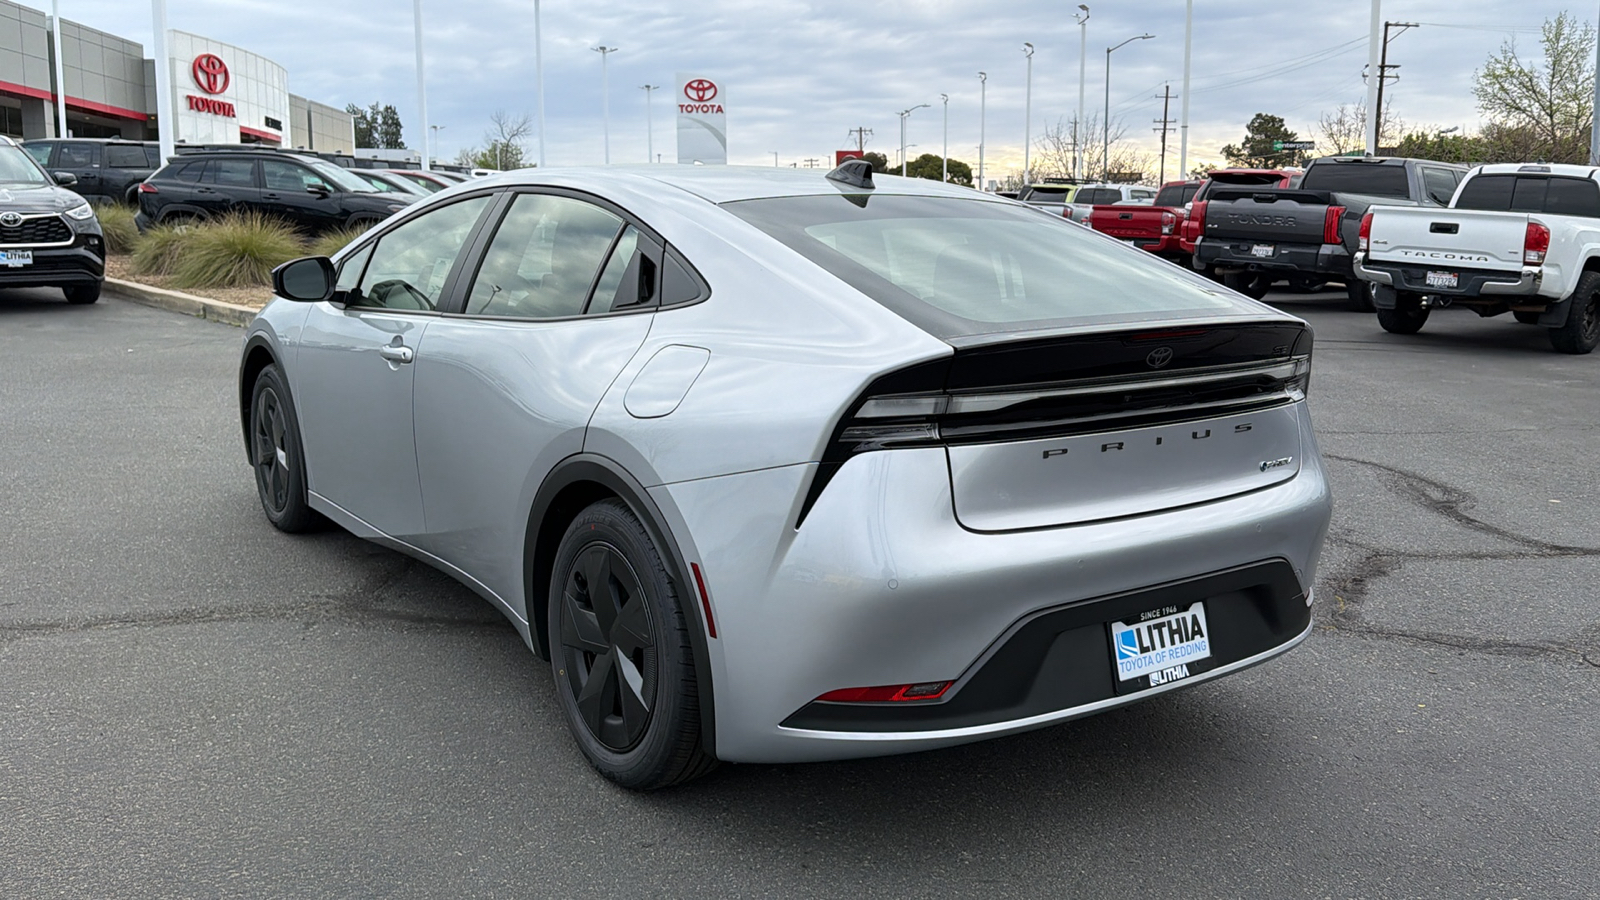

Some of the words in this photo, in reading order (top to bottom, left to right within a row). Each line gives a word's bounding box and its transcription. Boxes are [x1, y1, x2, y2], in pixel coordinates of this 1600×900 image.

[186, 94, 236, 118] TOYOTA
[678, 104, 724, 114] TOYOTA
[1228, 213, 1296, 227] TUNDRA
[1401, 250, 1489, 262] TACOMA
[1042, 422, 1253, 459] PRIUS
[1140, 609, 1161, 621] SINCE
[1162, 605, 1178, 615] 1946
[1135, 613, 1205, 654] LITHIA
[1120, 655, 1155, 673] TOYOTA
[1155, 650, 1168, 664] OF
[1168, 640, 1207, 659] REDDING
[1158, 664, 1190, 684] LITHIA
